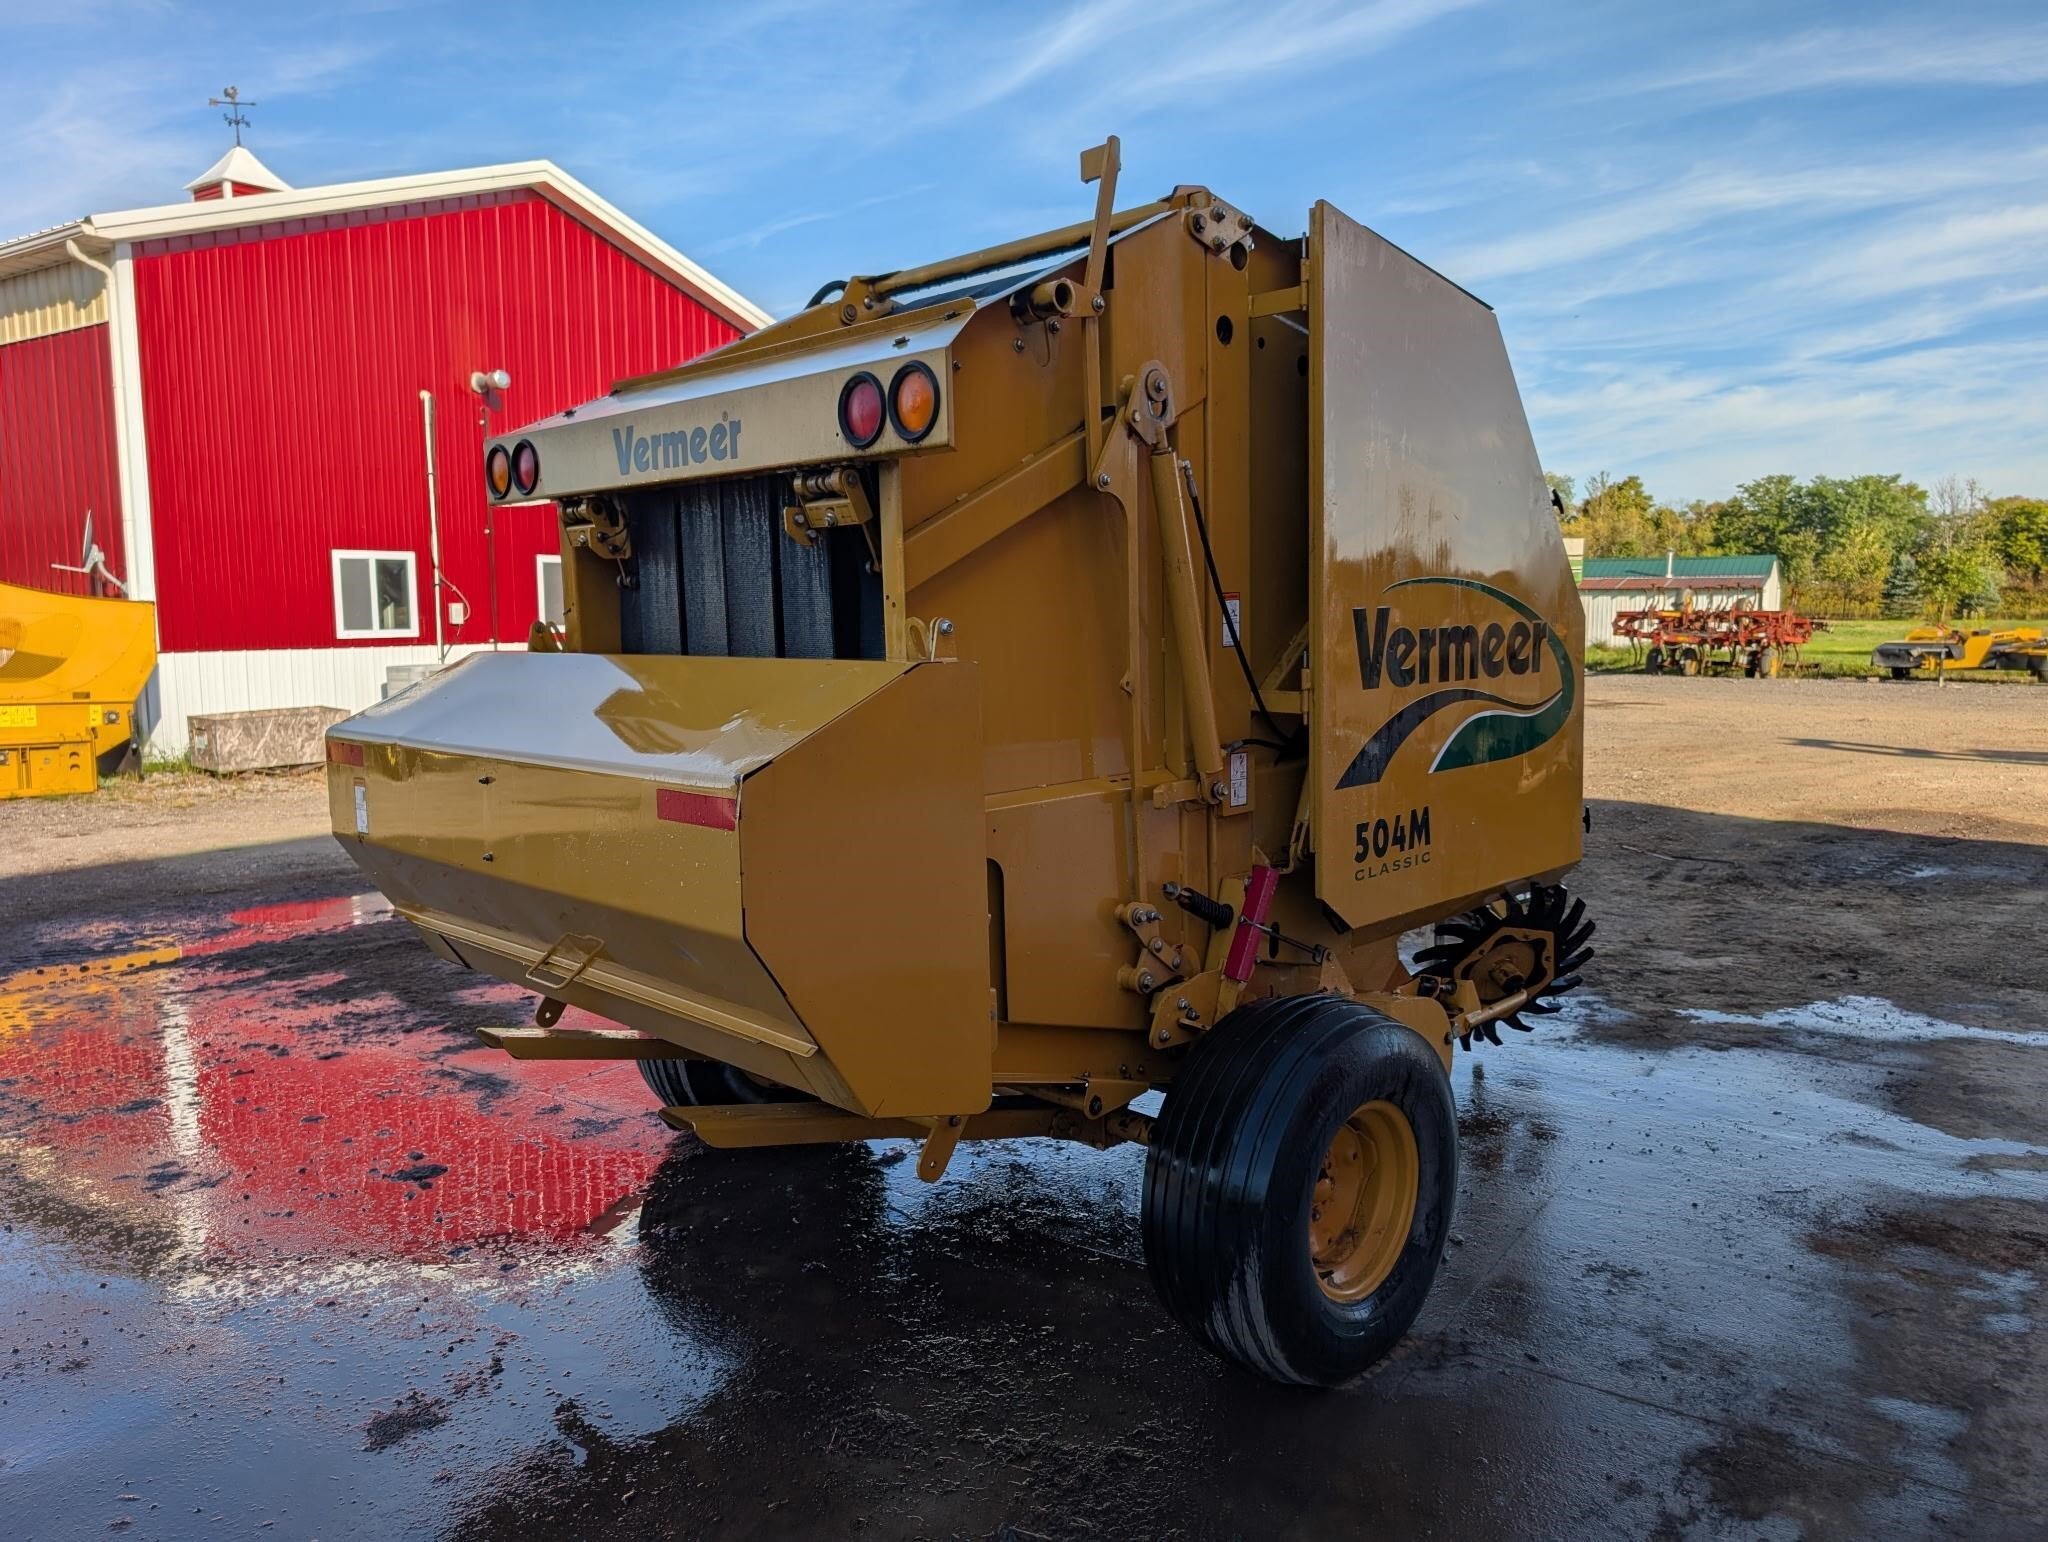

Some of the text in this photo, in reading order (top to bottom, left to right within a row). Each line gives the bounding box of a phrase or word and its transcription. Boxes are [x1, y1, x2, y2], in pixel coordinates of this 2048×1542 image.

[612, 420, 742, 476] Vermeer
[1352, 606, 1548, 690] Vermeer
[1354, 806, 1431, 863] 504M
[1354, 852, 1431, 881] CLASSIC
